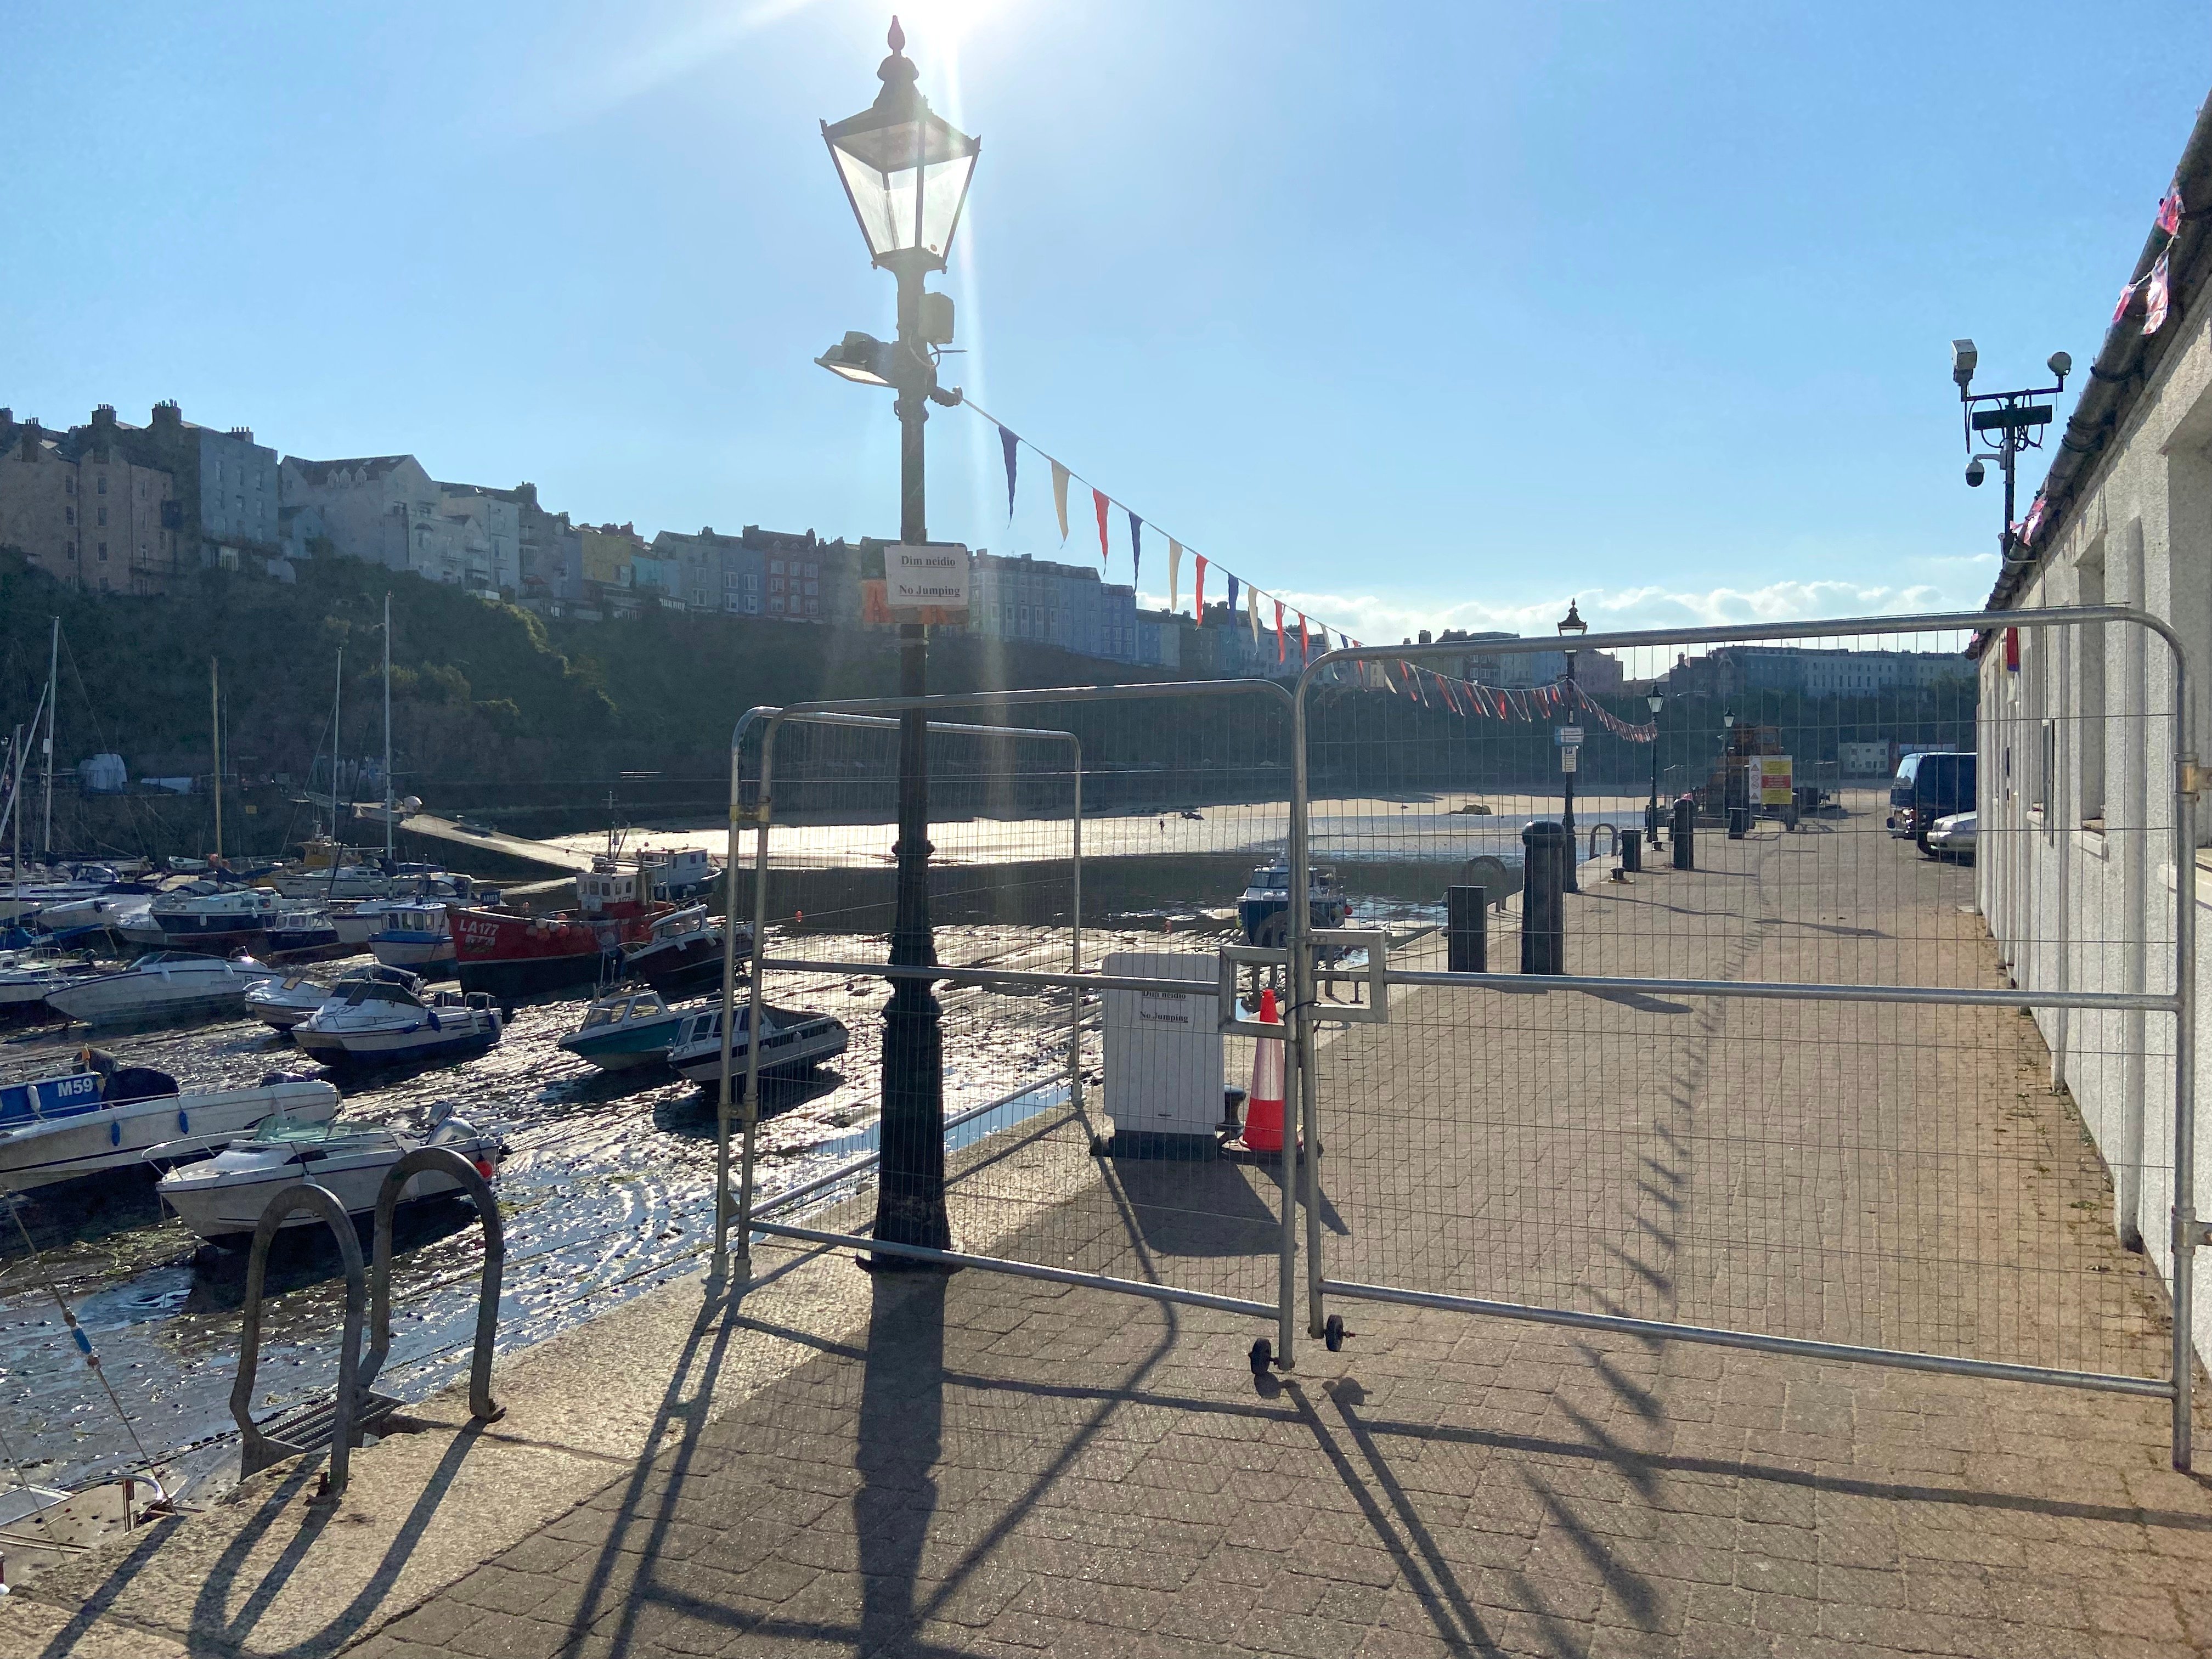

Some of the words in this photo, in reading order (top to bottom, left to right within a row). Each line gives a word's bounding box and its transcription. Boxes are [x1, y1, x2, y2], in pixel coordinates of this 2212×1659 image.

[901, 555, 922, 566] Dim
[926, 556, 956, 566] neidio
[899, 585, 913, 595] No
[916, 585, 960, 597] Jumping
[459, 919, 500, 935] LA177
[1152, 1012, 1189, 1023] Jumping
[57, 1078, 93, 1097] M59
